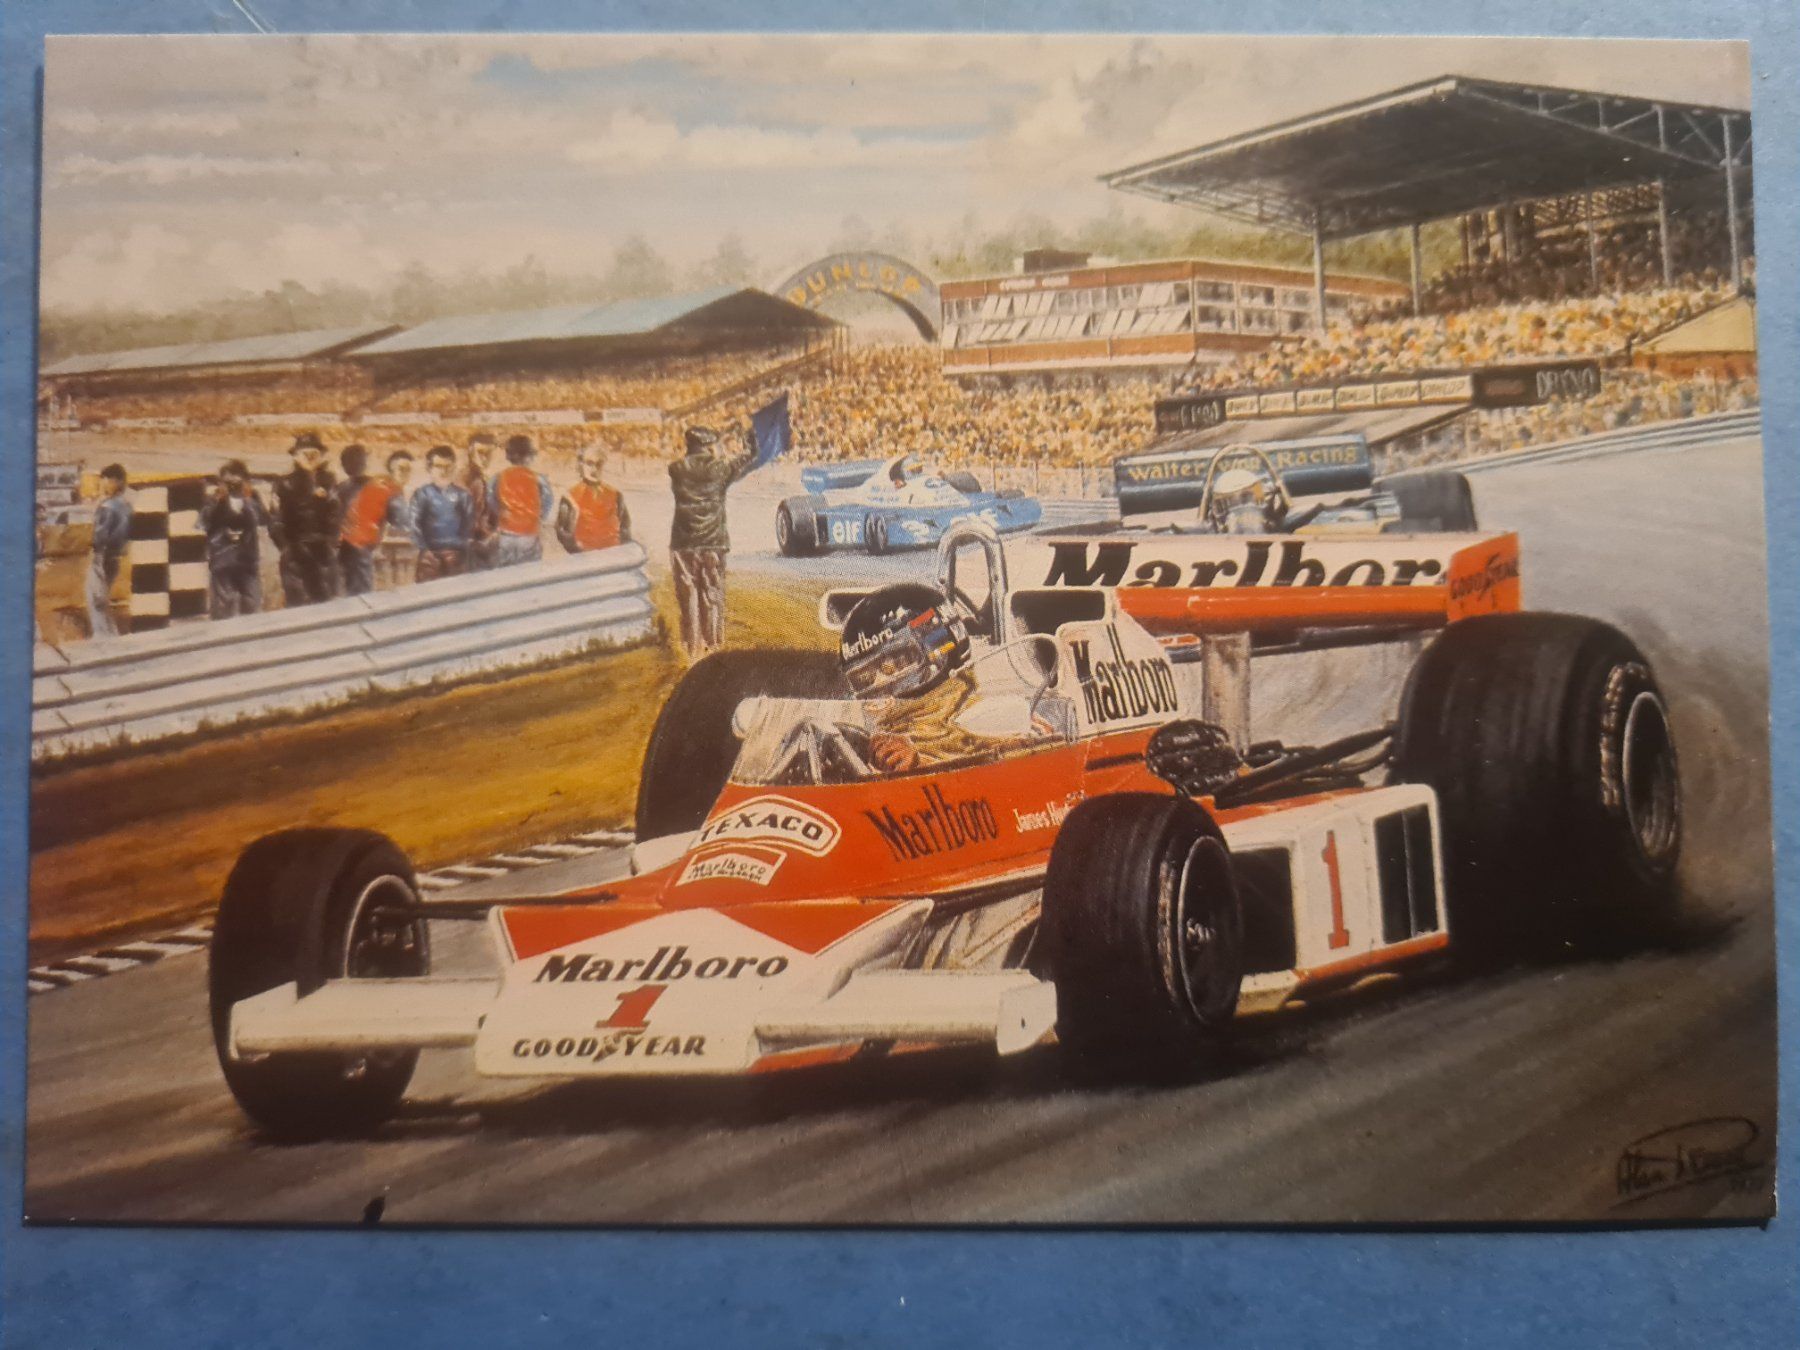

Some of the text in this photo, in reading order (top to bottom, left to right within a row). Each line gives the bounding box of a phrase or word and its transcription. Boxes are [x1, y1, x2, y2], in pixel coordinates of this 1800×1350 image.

[1277, 445, 1358, 469] Racing
[1042, 541, 1447, 587] Marlbor
[842, 628, 894, 660] Marlboro
[1068, 622, 1179, 725] Marlboro
[701, 812, 824, 842] TEXACO
[862, 783, 1000, 863] Marlboro
[691, 858, 767, 875] Marlboro
[1322, 830, 1349, 950] 1
[532, 945, 790, 983] Marlboro
[595, 984, 668, 1029] 1
